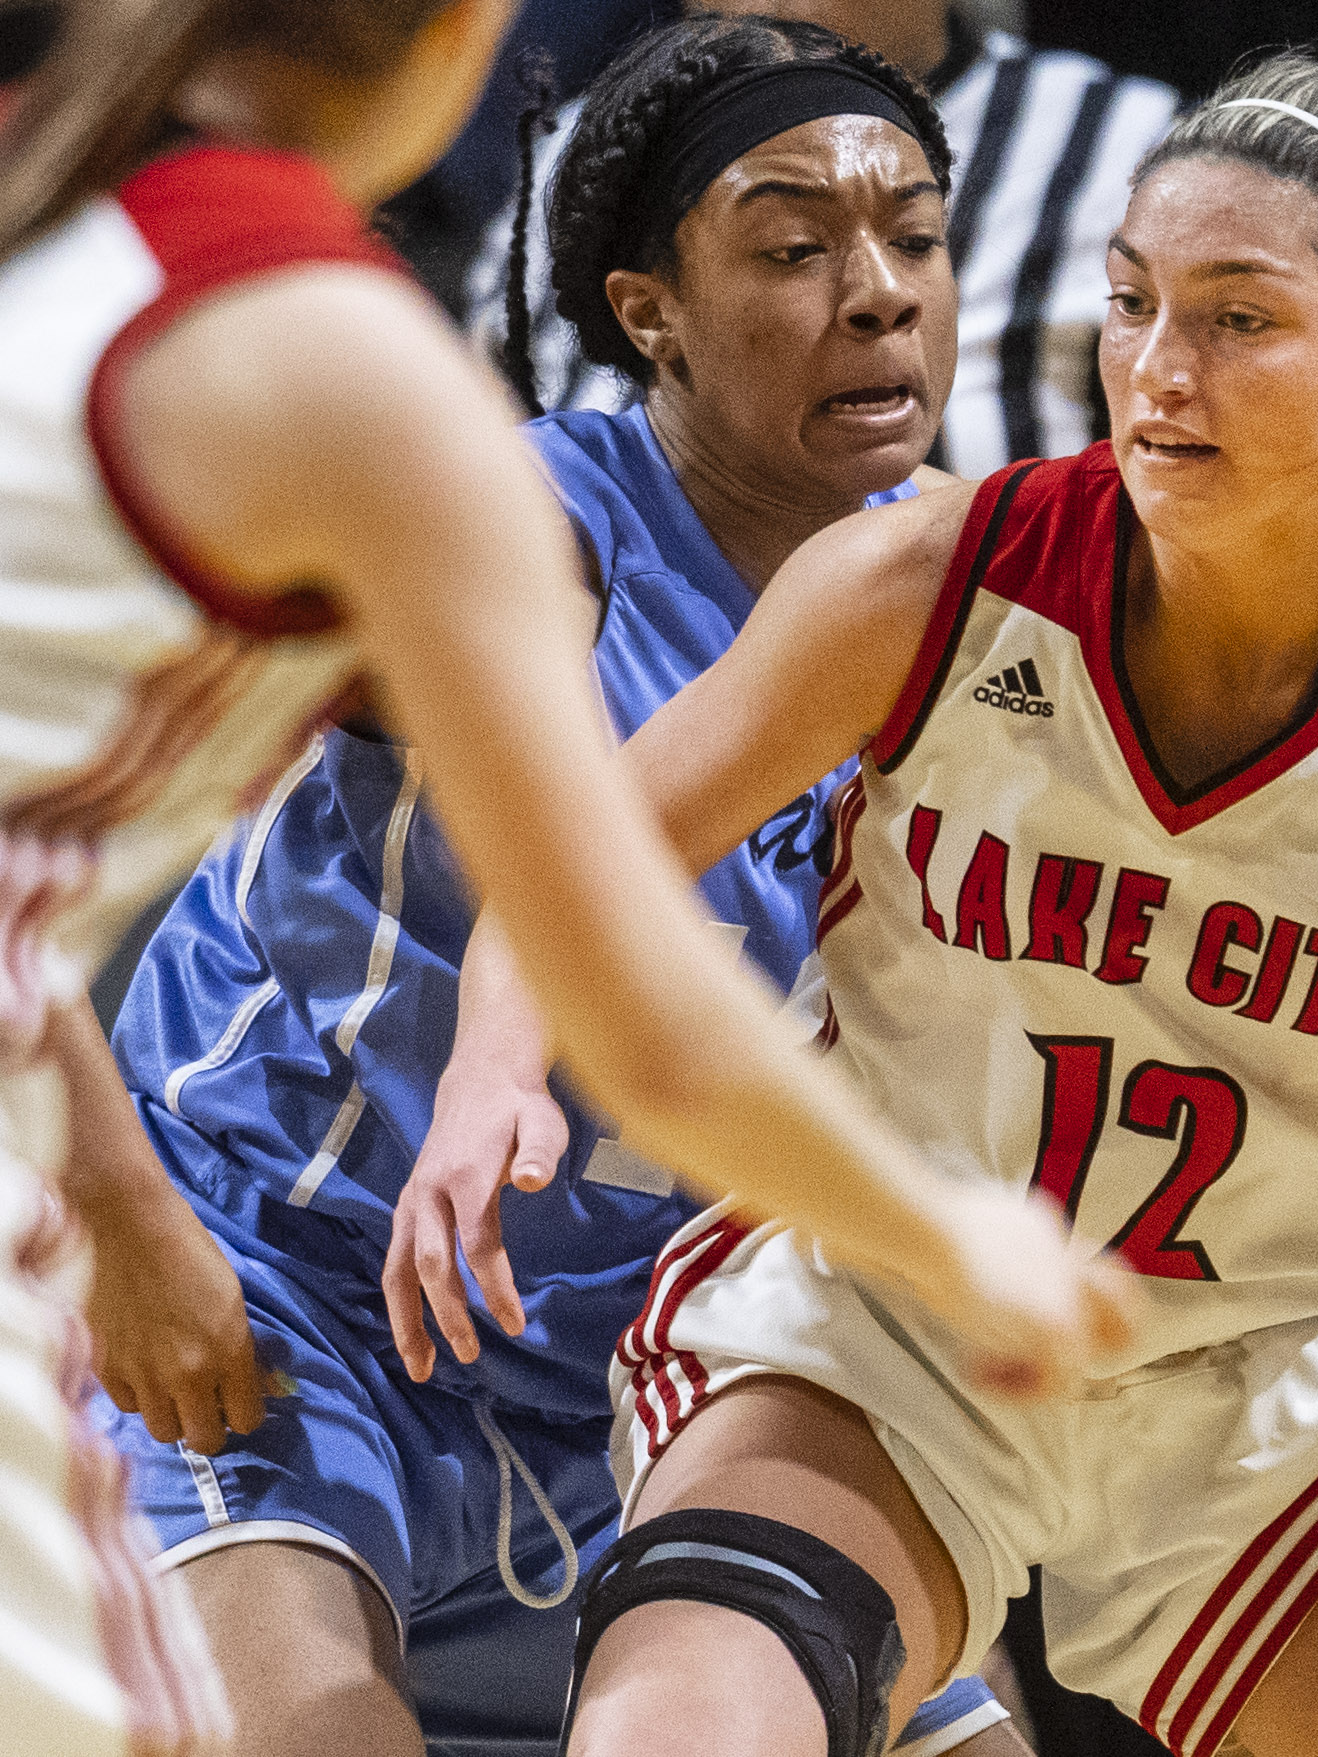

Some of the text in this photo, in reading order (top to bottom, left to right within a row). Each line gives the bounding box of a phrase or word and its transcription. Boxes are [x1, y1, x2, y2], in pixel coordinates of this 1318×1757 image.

[973, 686, 1055, 718] adidas
[905, 803, 1171, 987] LAKE
[1023, 1028, 1249, 1282] 12
